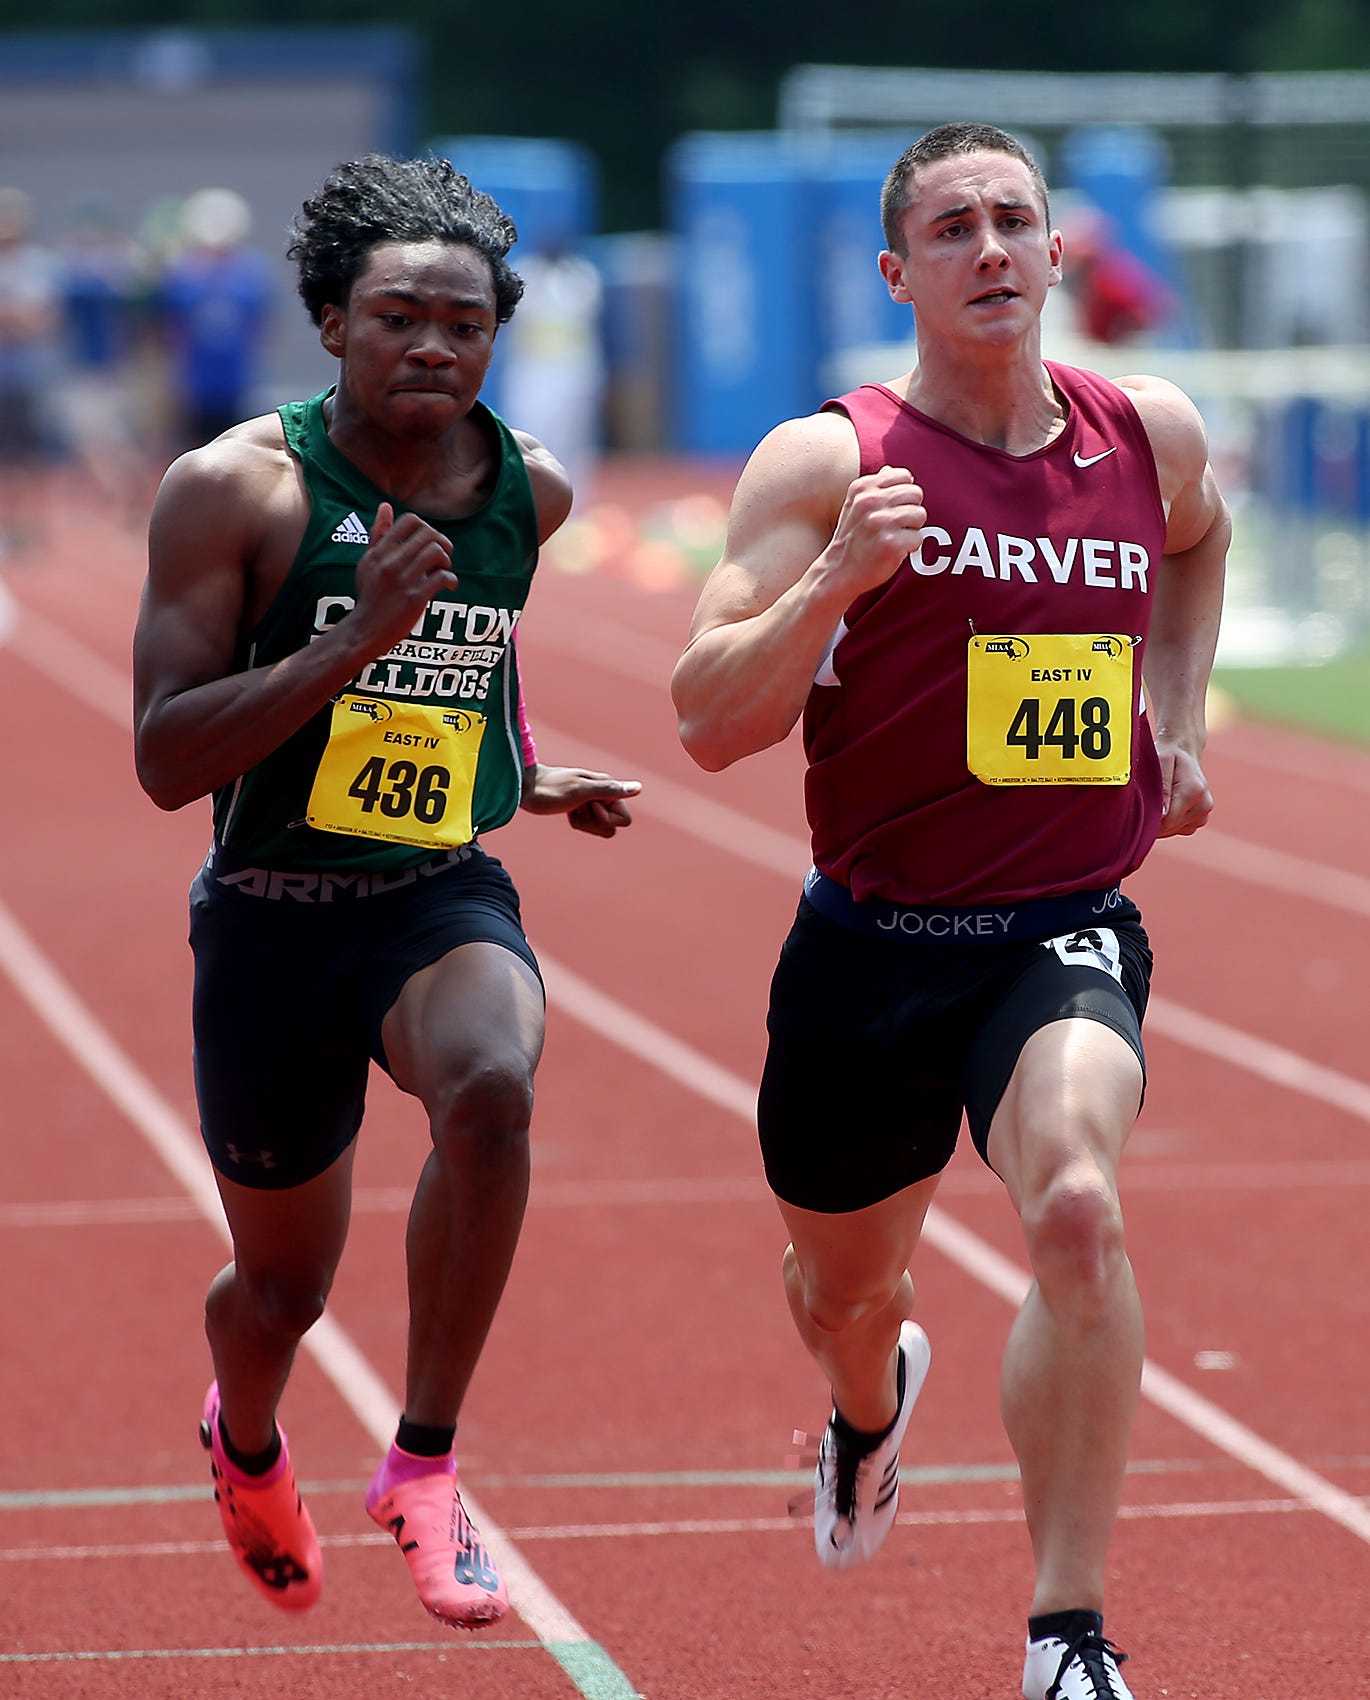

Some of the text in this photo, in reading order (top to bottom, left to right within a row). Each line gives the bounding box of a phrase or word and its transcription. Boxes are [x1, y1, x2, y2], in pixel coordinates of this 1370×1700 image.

[331, 532, 371, 545] adida
[909, 526, 1149, 594] CARVER
[314, 596, 522, 645] CTON
[387, 643, 448, 661] RACK
[345, 662, 492, 700] LLDOGS
[1031, 669, 1092, 682] EAST IV
[383, 731, 440, 750] EAST IV
[1006, 697, 1112, 760] 448
[348, 756, 450, 824] 436
[877, 911, 1016, 936] JOCKEY
